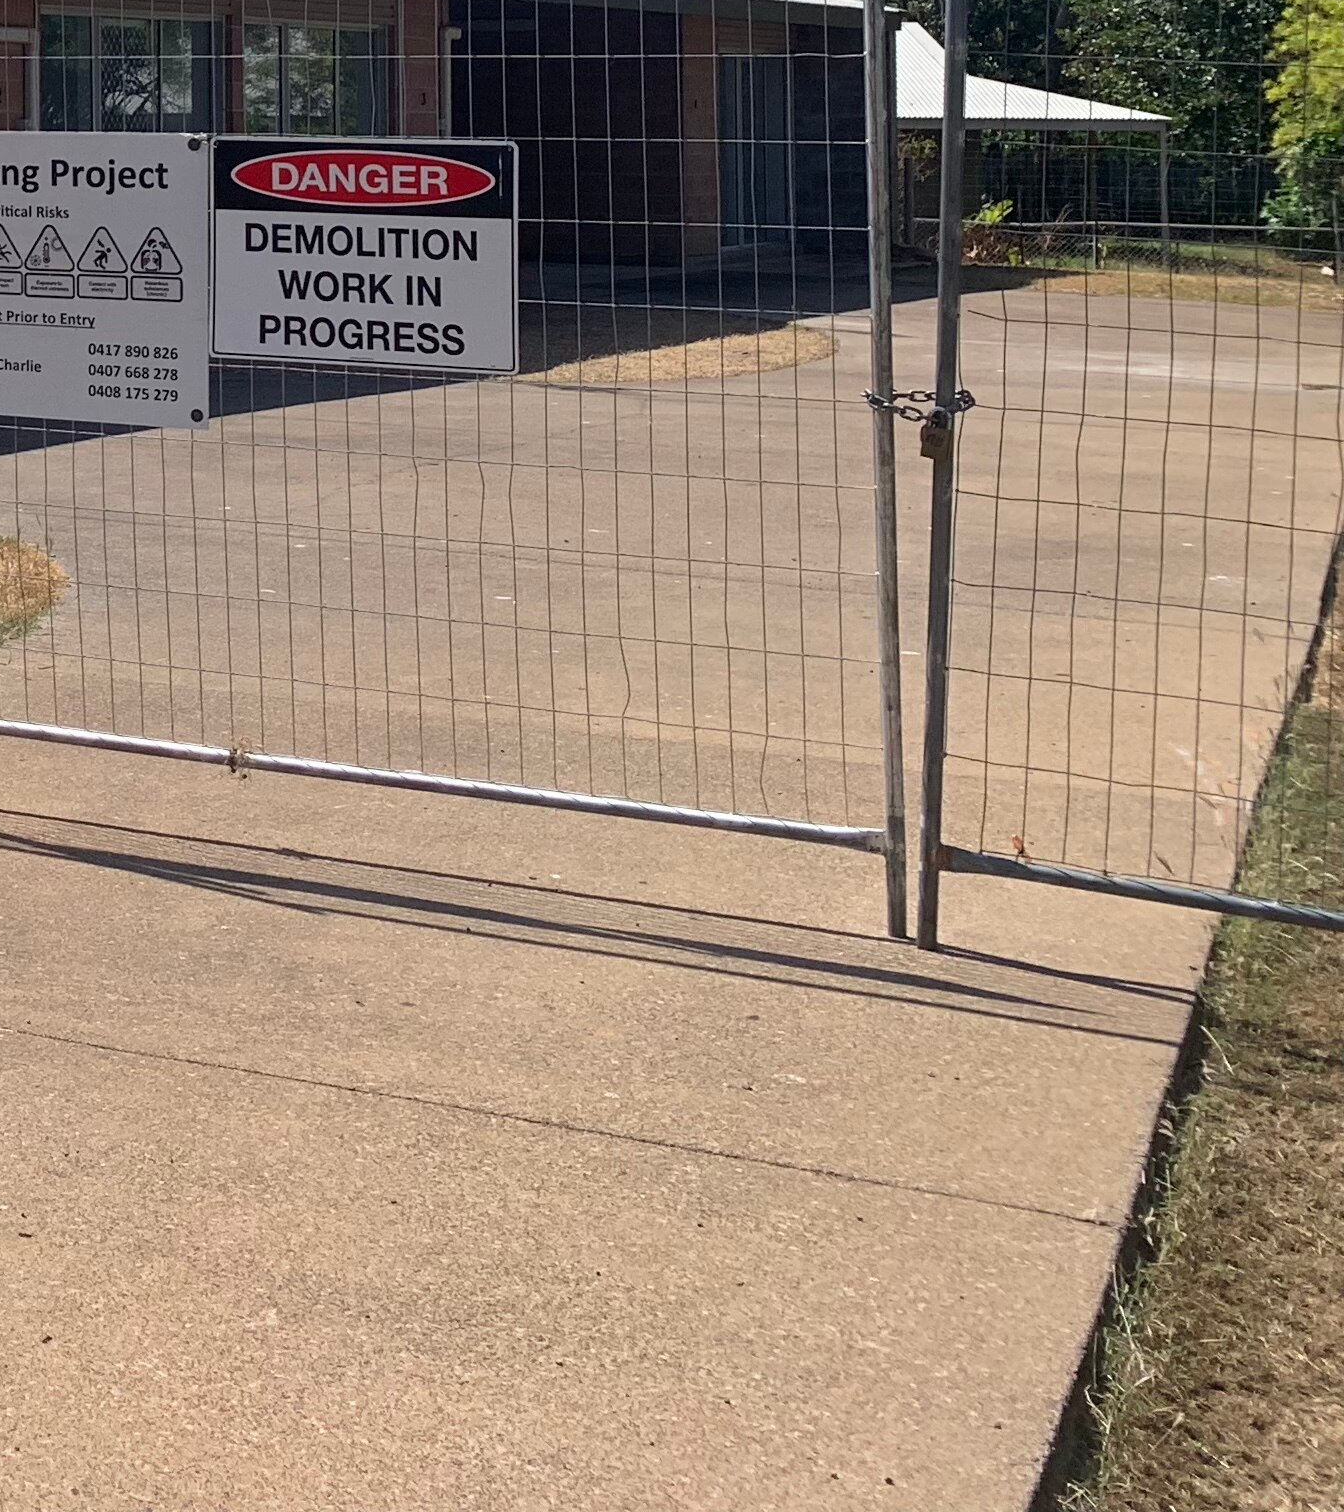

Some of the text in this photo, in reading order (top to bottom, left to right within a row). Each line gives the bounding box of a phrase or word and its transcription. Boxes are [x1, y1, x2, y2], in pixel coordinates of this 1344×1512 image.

[50, 159, 169, 195] Project
[271, 161, 449, 196] DANGER
[36, 205, 70, 219] Risks
[244, 222, 478, 262] DEMOLITION
[278, 269, 442, 307] WORK IN
[6, 310, 39, 324] Prior
[42, 312, 56, 325] to
[60, 313, 96, 329] Entry
[259, 314, 466, 356] PROGRESS
[88, 343, 179, 360] 0417 890 826
[88, 364, 179, 381] 0407 668 278
[88, 385, 179, 402] 0408 175 279
